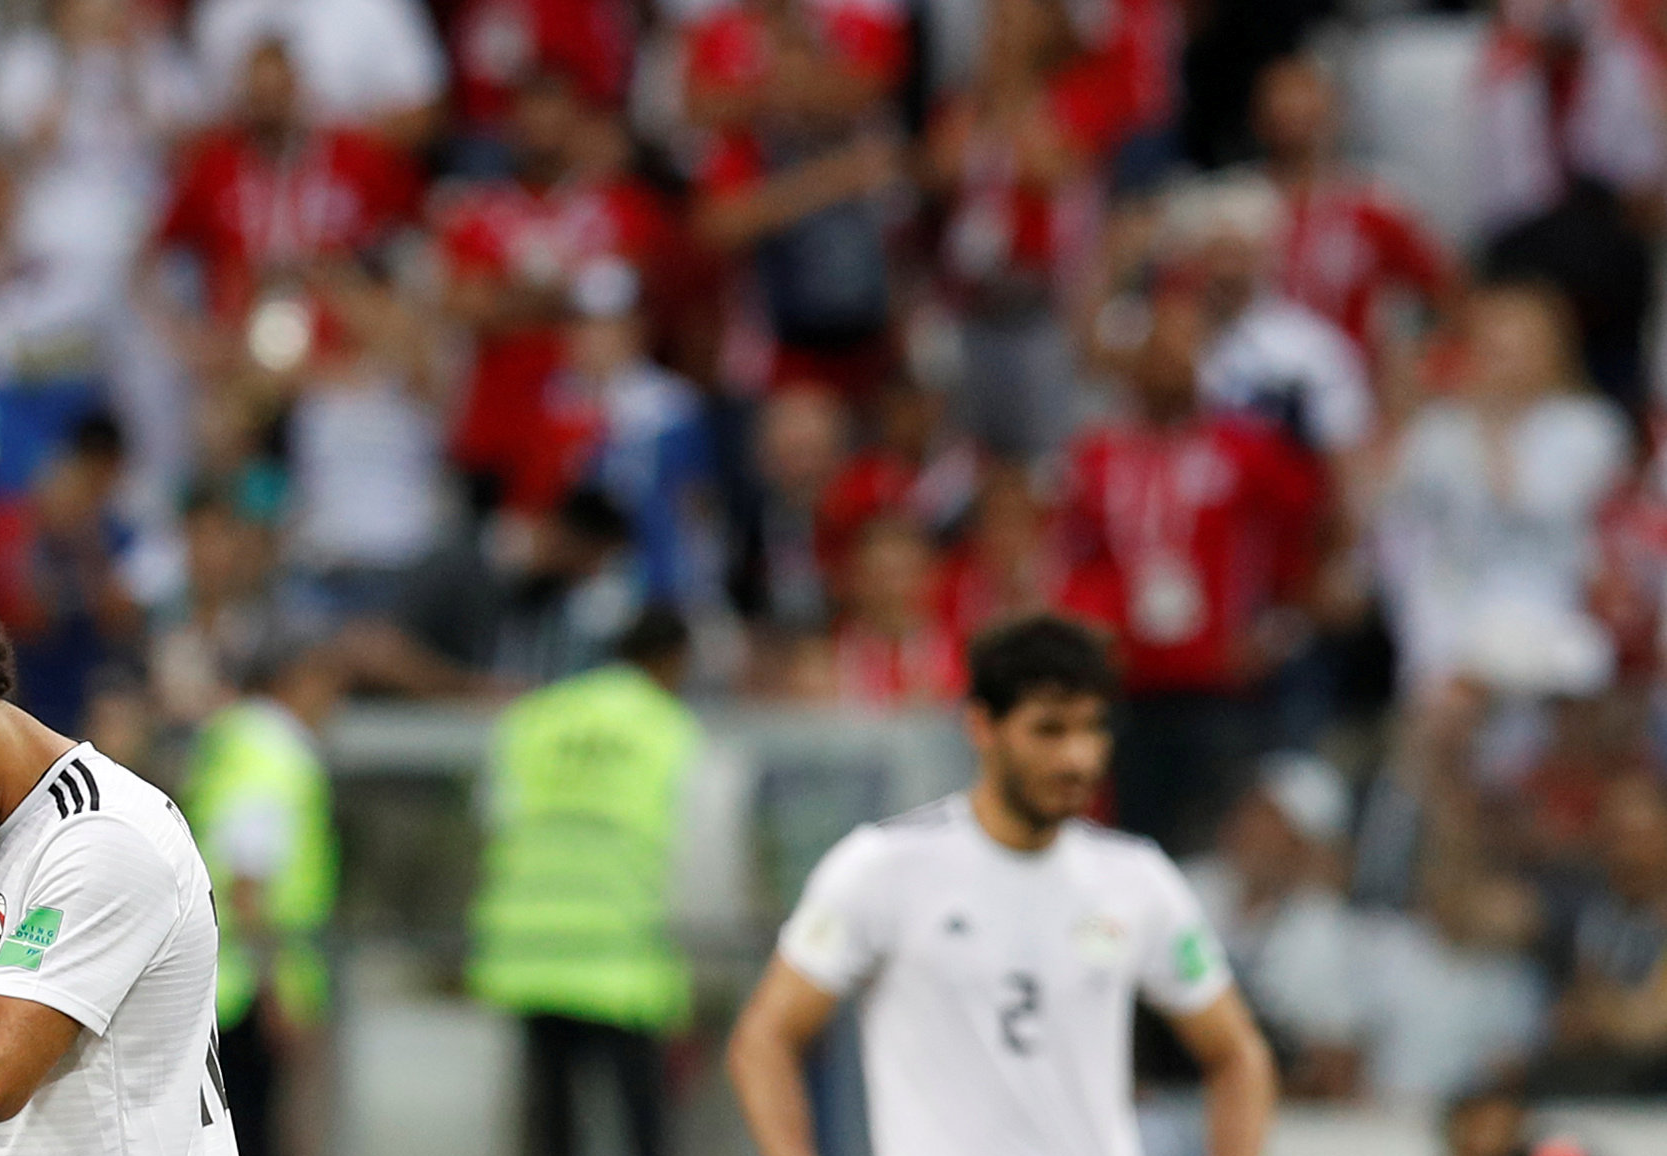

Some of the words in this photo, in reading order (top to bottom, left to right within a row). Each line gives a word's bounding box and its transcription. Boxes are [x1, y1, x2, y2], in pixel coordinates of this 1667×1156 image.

[15, 930, 51, 945] OTBALL
[20, 923, 55, 938] VING
[998, 970, 1041, 1057] 2
